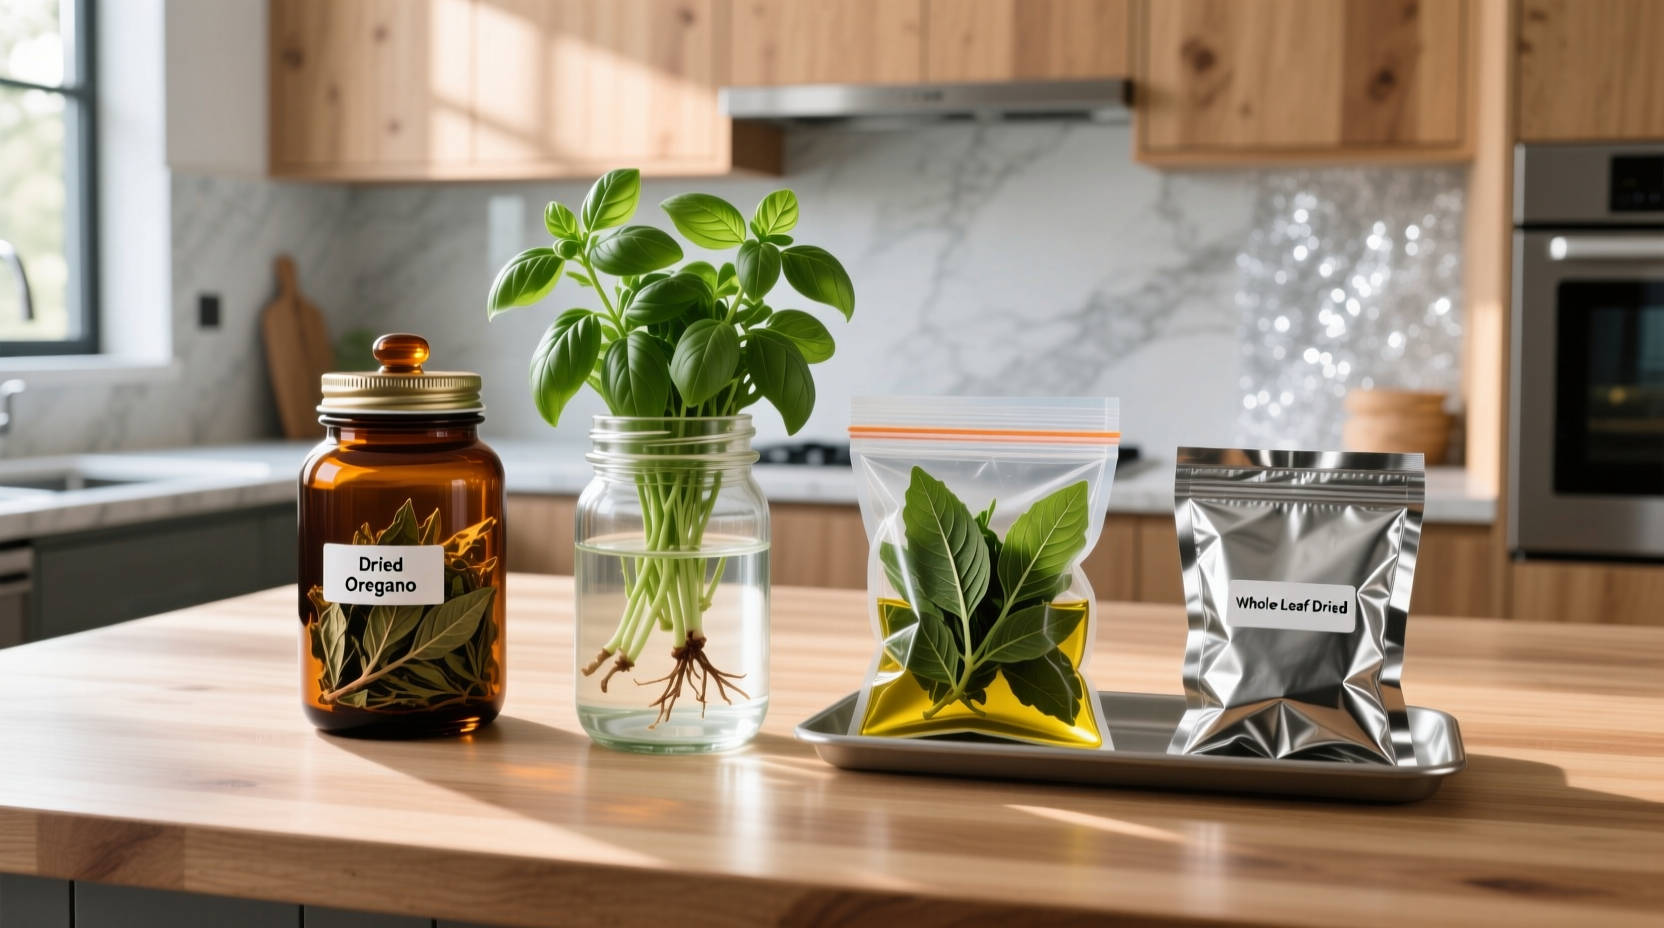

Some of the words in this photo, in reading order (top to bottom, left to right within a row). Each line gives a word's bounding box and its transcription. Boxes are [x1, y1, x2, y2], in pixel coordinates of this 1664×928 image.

[359, 556, 403, 572] Dried
[345, 576, 417, 597] Oregano
[1236, 596, 1278, 610] Whole
[1280, 598, 1311, 612] Leaf
[1312, 600, 1348, 614] Dried
